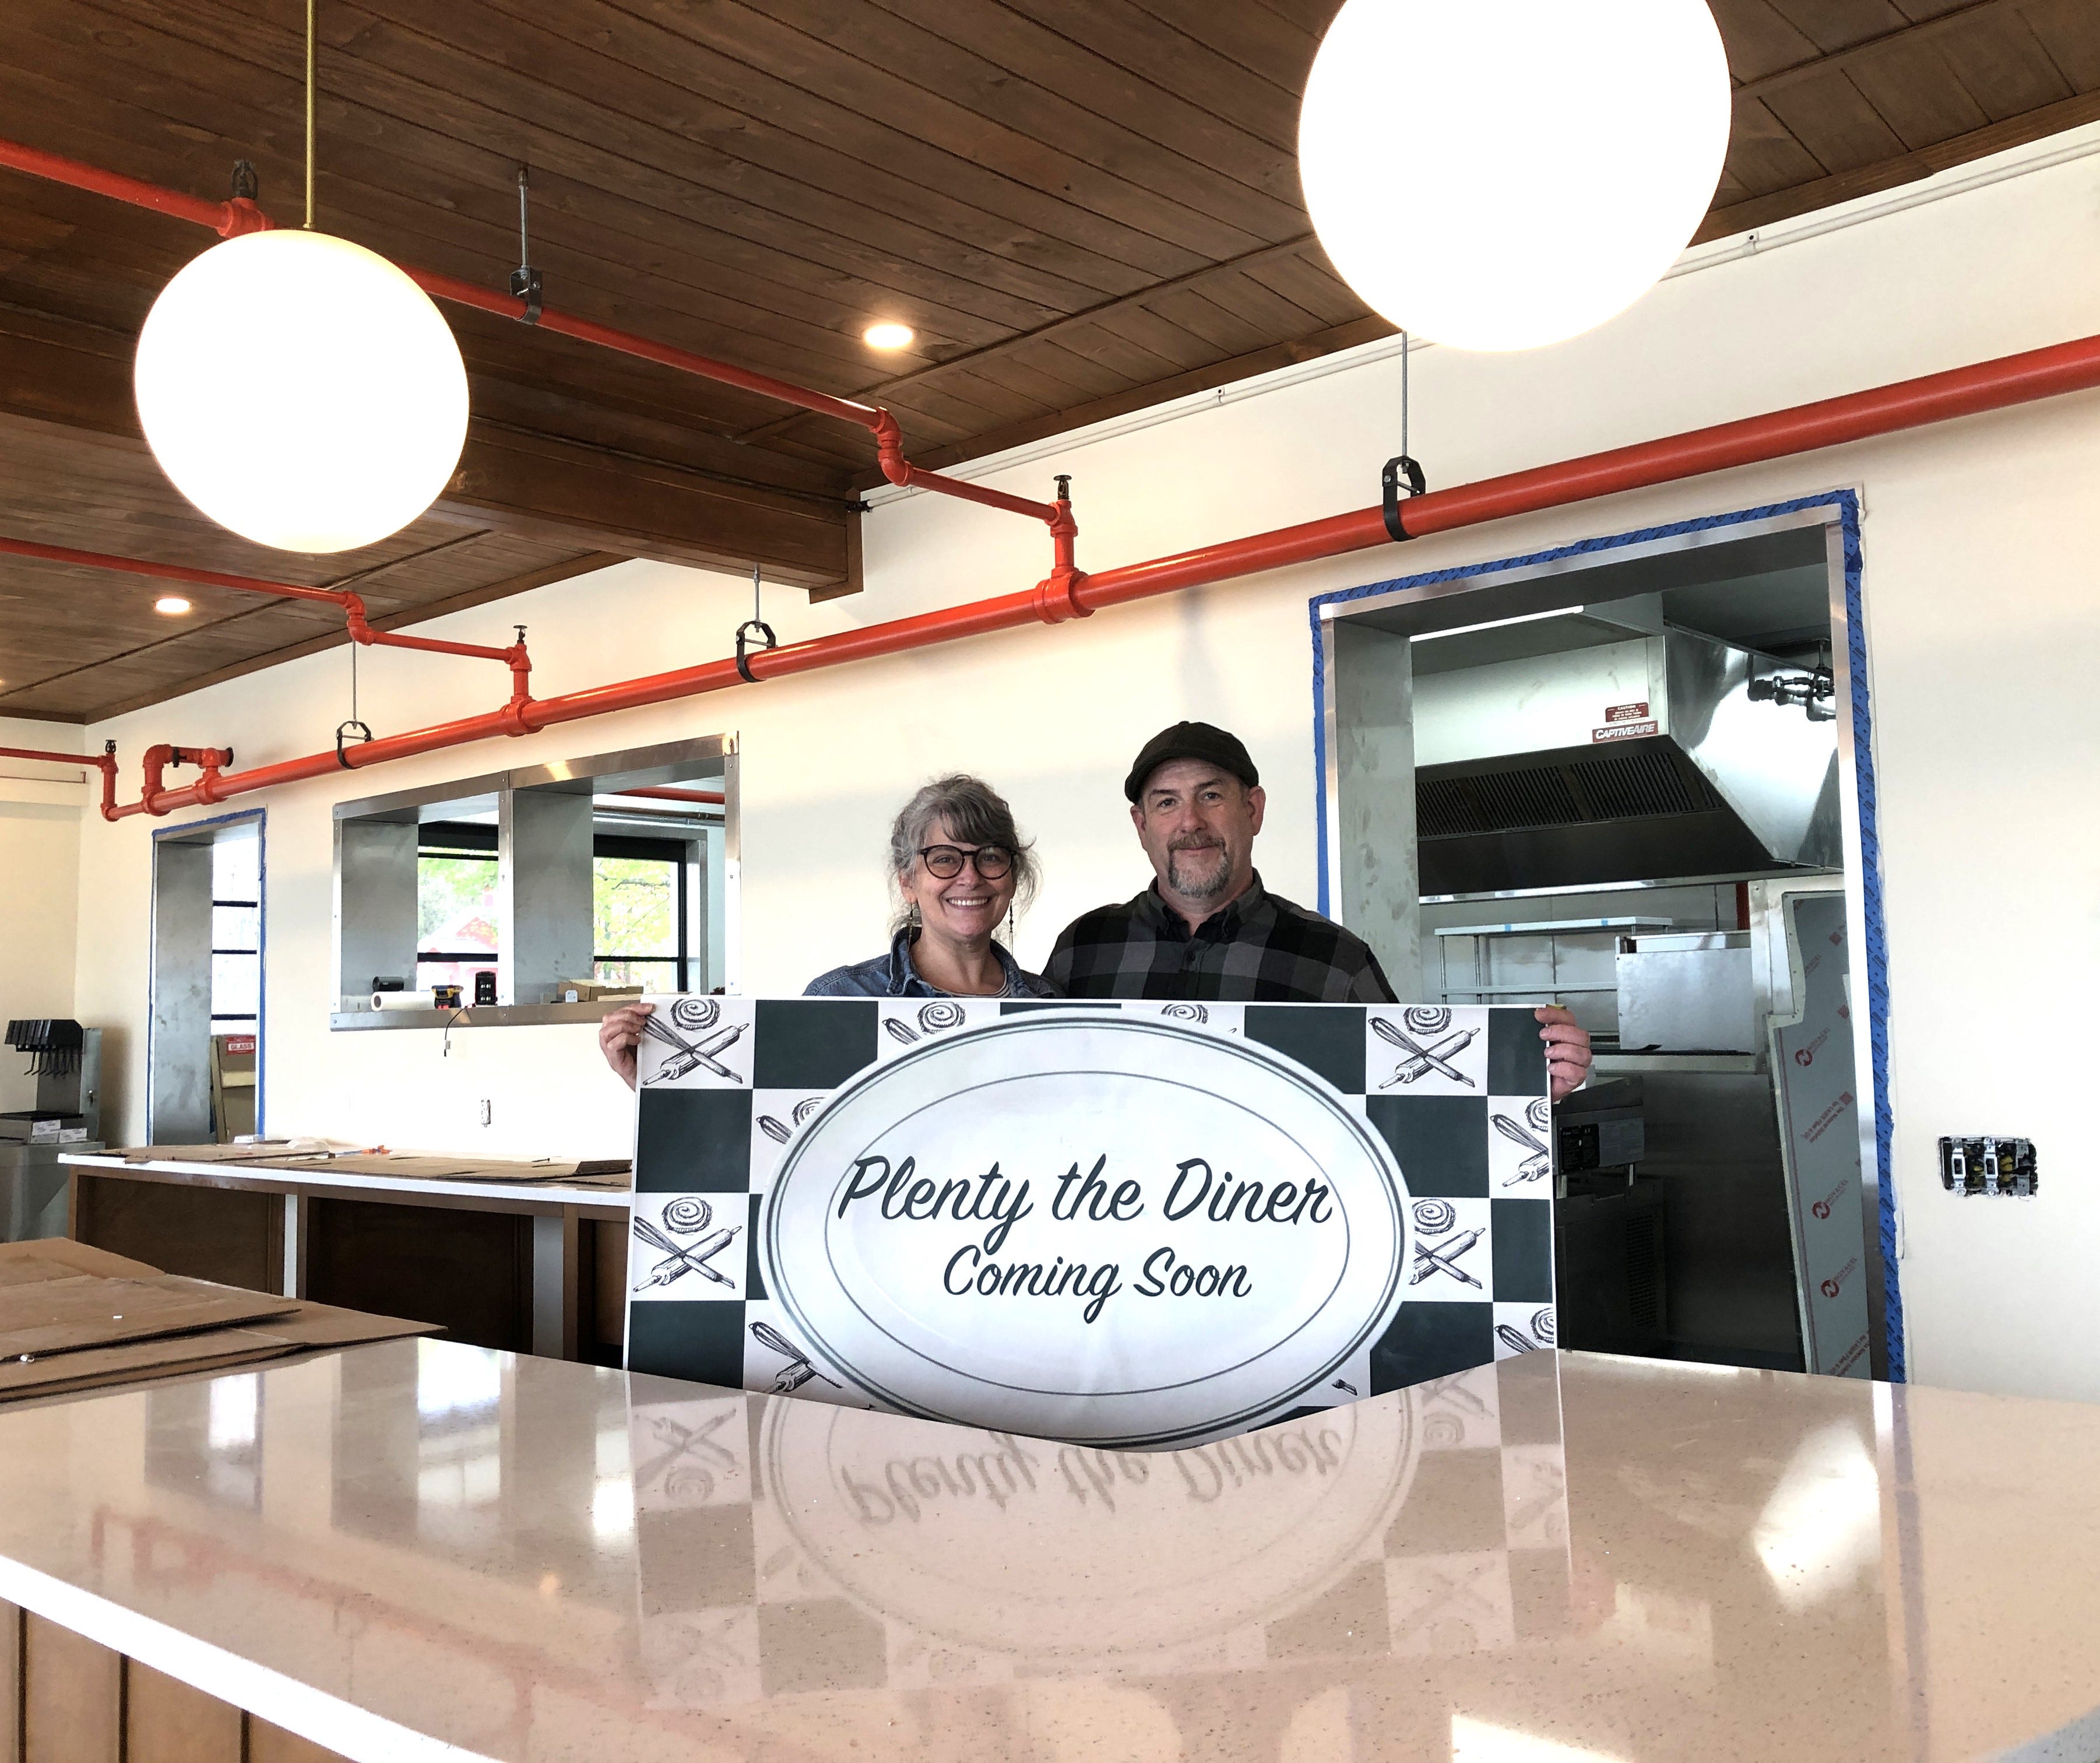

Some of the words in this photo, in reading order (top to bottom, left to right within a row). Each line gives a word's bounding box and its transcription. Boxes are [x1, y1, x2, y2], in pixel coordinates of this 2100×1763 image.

[1595, 723, 1655, 739] CAPTIVEAIRE
[838, 1156, 1033, 1255] Plenty
[1051, 1153, 1144, 1221] the
[1163, 1158, 1332, 1225] Diner
[943, 1245, 1123, 1324] Coming
[1133, 1246, 1252, 1297] Soon
